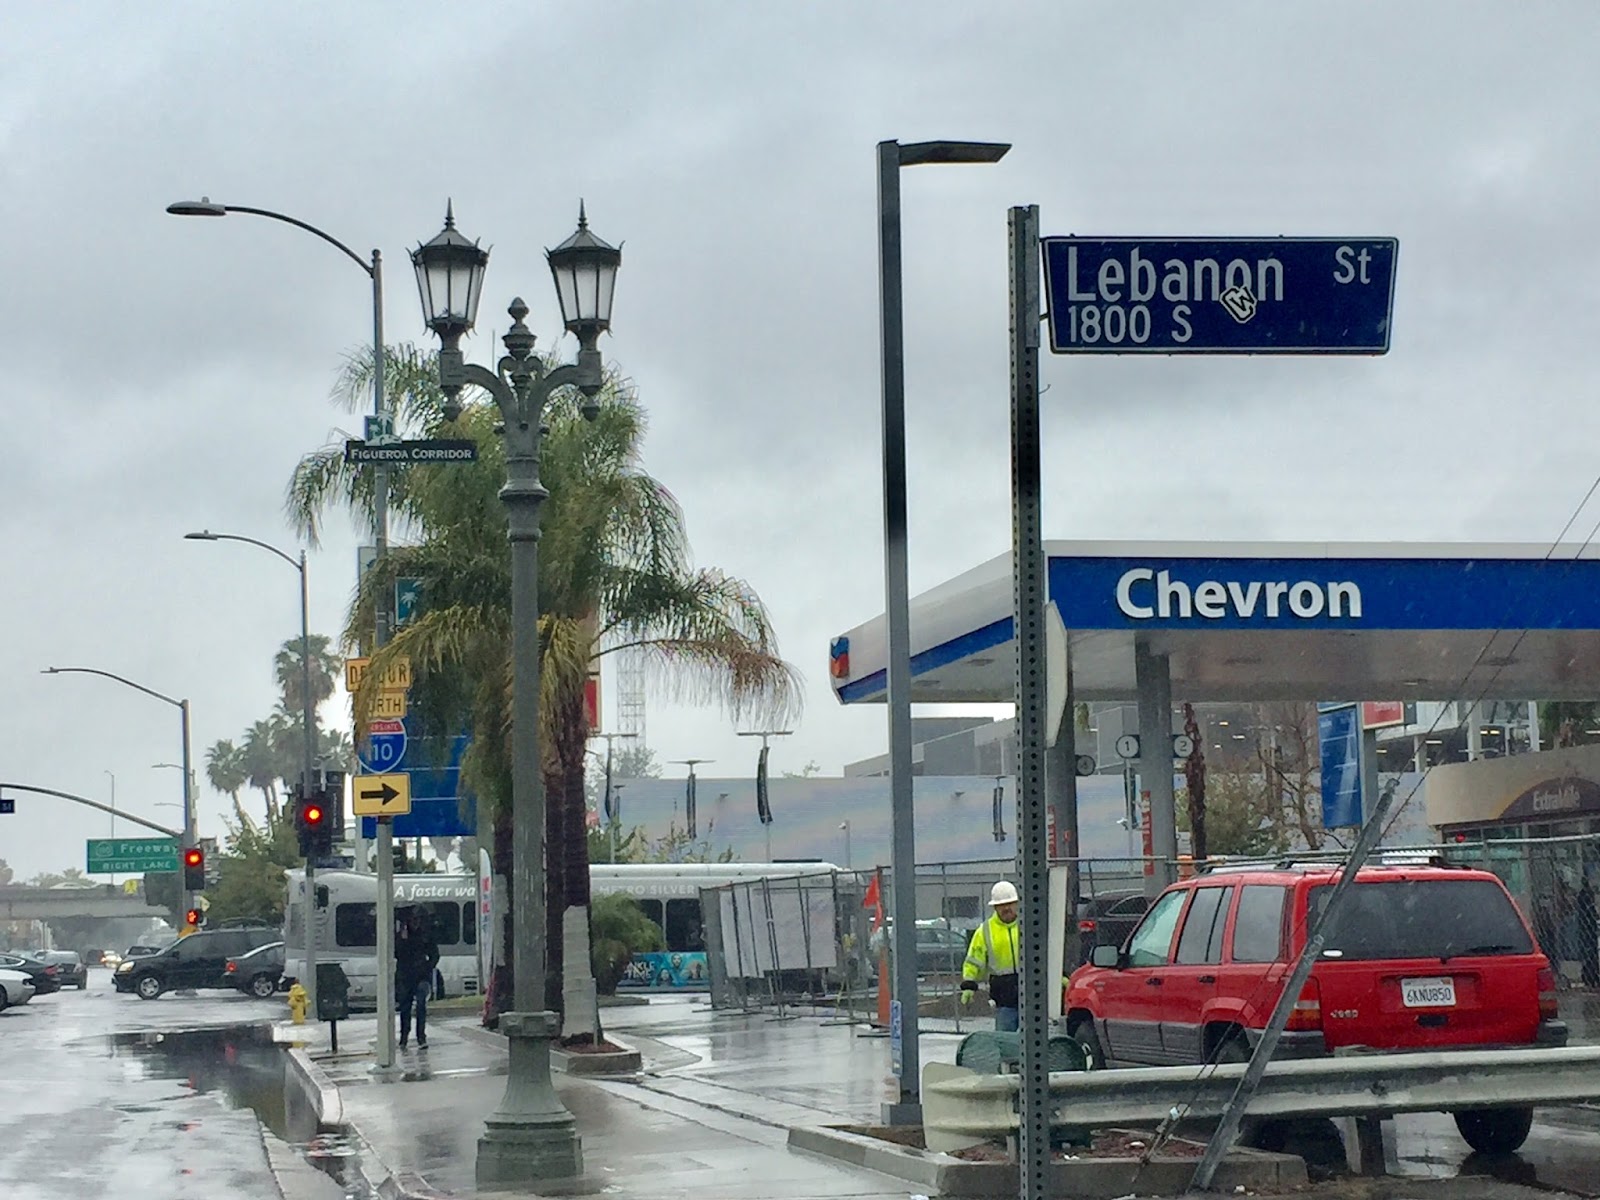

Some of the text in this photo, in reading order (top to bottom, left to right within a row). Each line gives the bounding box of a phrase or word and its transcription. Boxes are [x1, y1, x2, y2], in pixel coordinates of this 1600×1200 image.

[1067, 245, 1372, 302] Lebanon St
[1068, 304, 1193, 344] 1800 S
[351, 447, 472, 460] FIGUEROA CORRIDOR
[1116, 567, 1363, 619] Chevron
[349, 663, 407, 685] DEUR
[367, 698, 402, 713] ORTH
[1179, 740, 1188, 752] 2
[120, 843, 178, 855] Freeway
[394, 883, 477, 902] A faster wa
[649, 884, 695, 895] SILVER
